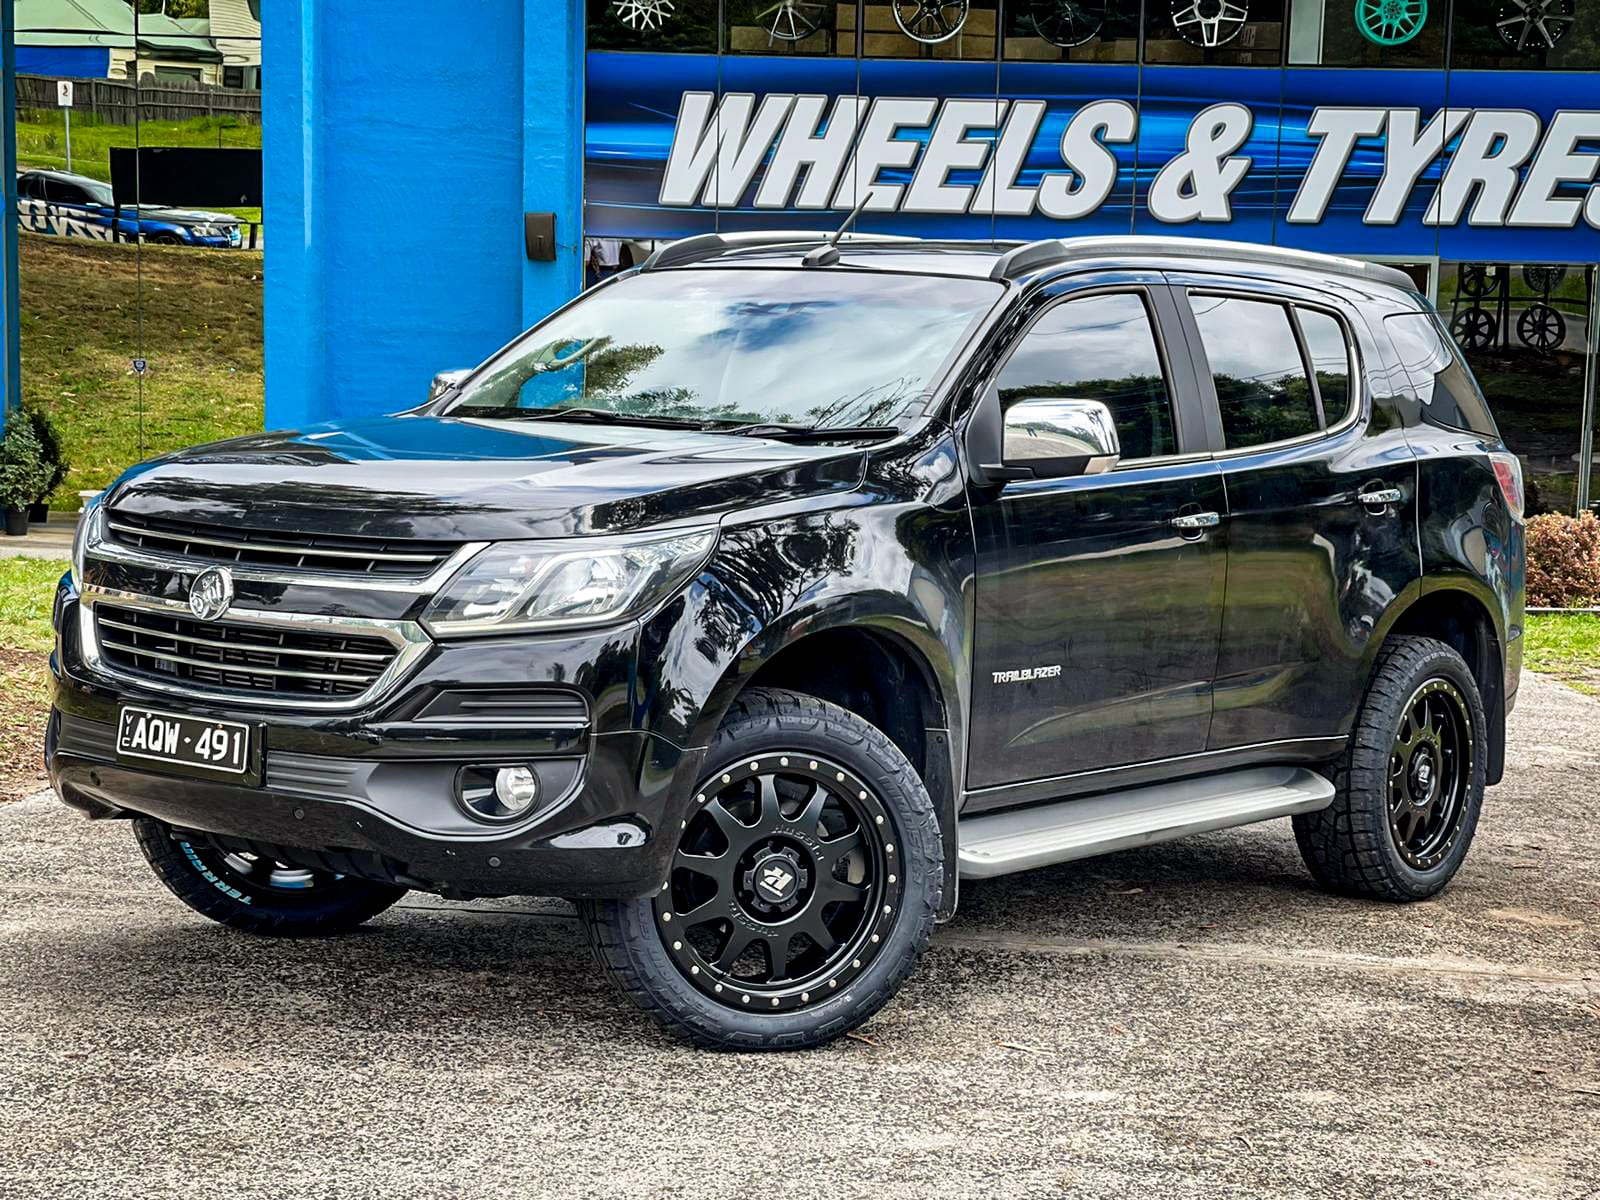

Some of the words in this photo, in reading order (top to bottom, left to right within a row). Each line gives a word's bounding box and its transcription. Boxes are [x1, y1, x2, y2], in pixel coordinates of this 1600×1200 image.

[658, 91, 1137, 220] WHEELS
[1147, 102, 1253, 223] &
[1286, 106, 1600, 230] TYRE
[991, 664, 1062, 684] TRAILBLAZER
[121, 714, 134, 747] VIC
[180, 841, 252, 905] TERRAIN
